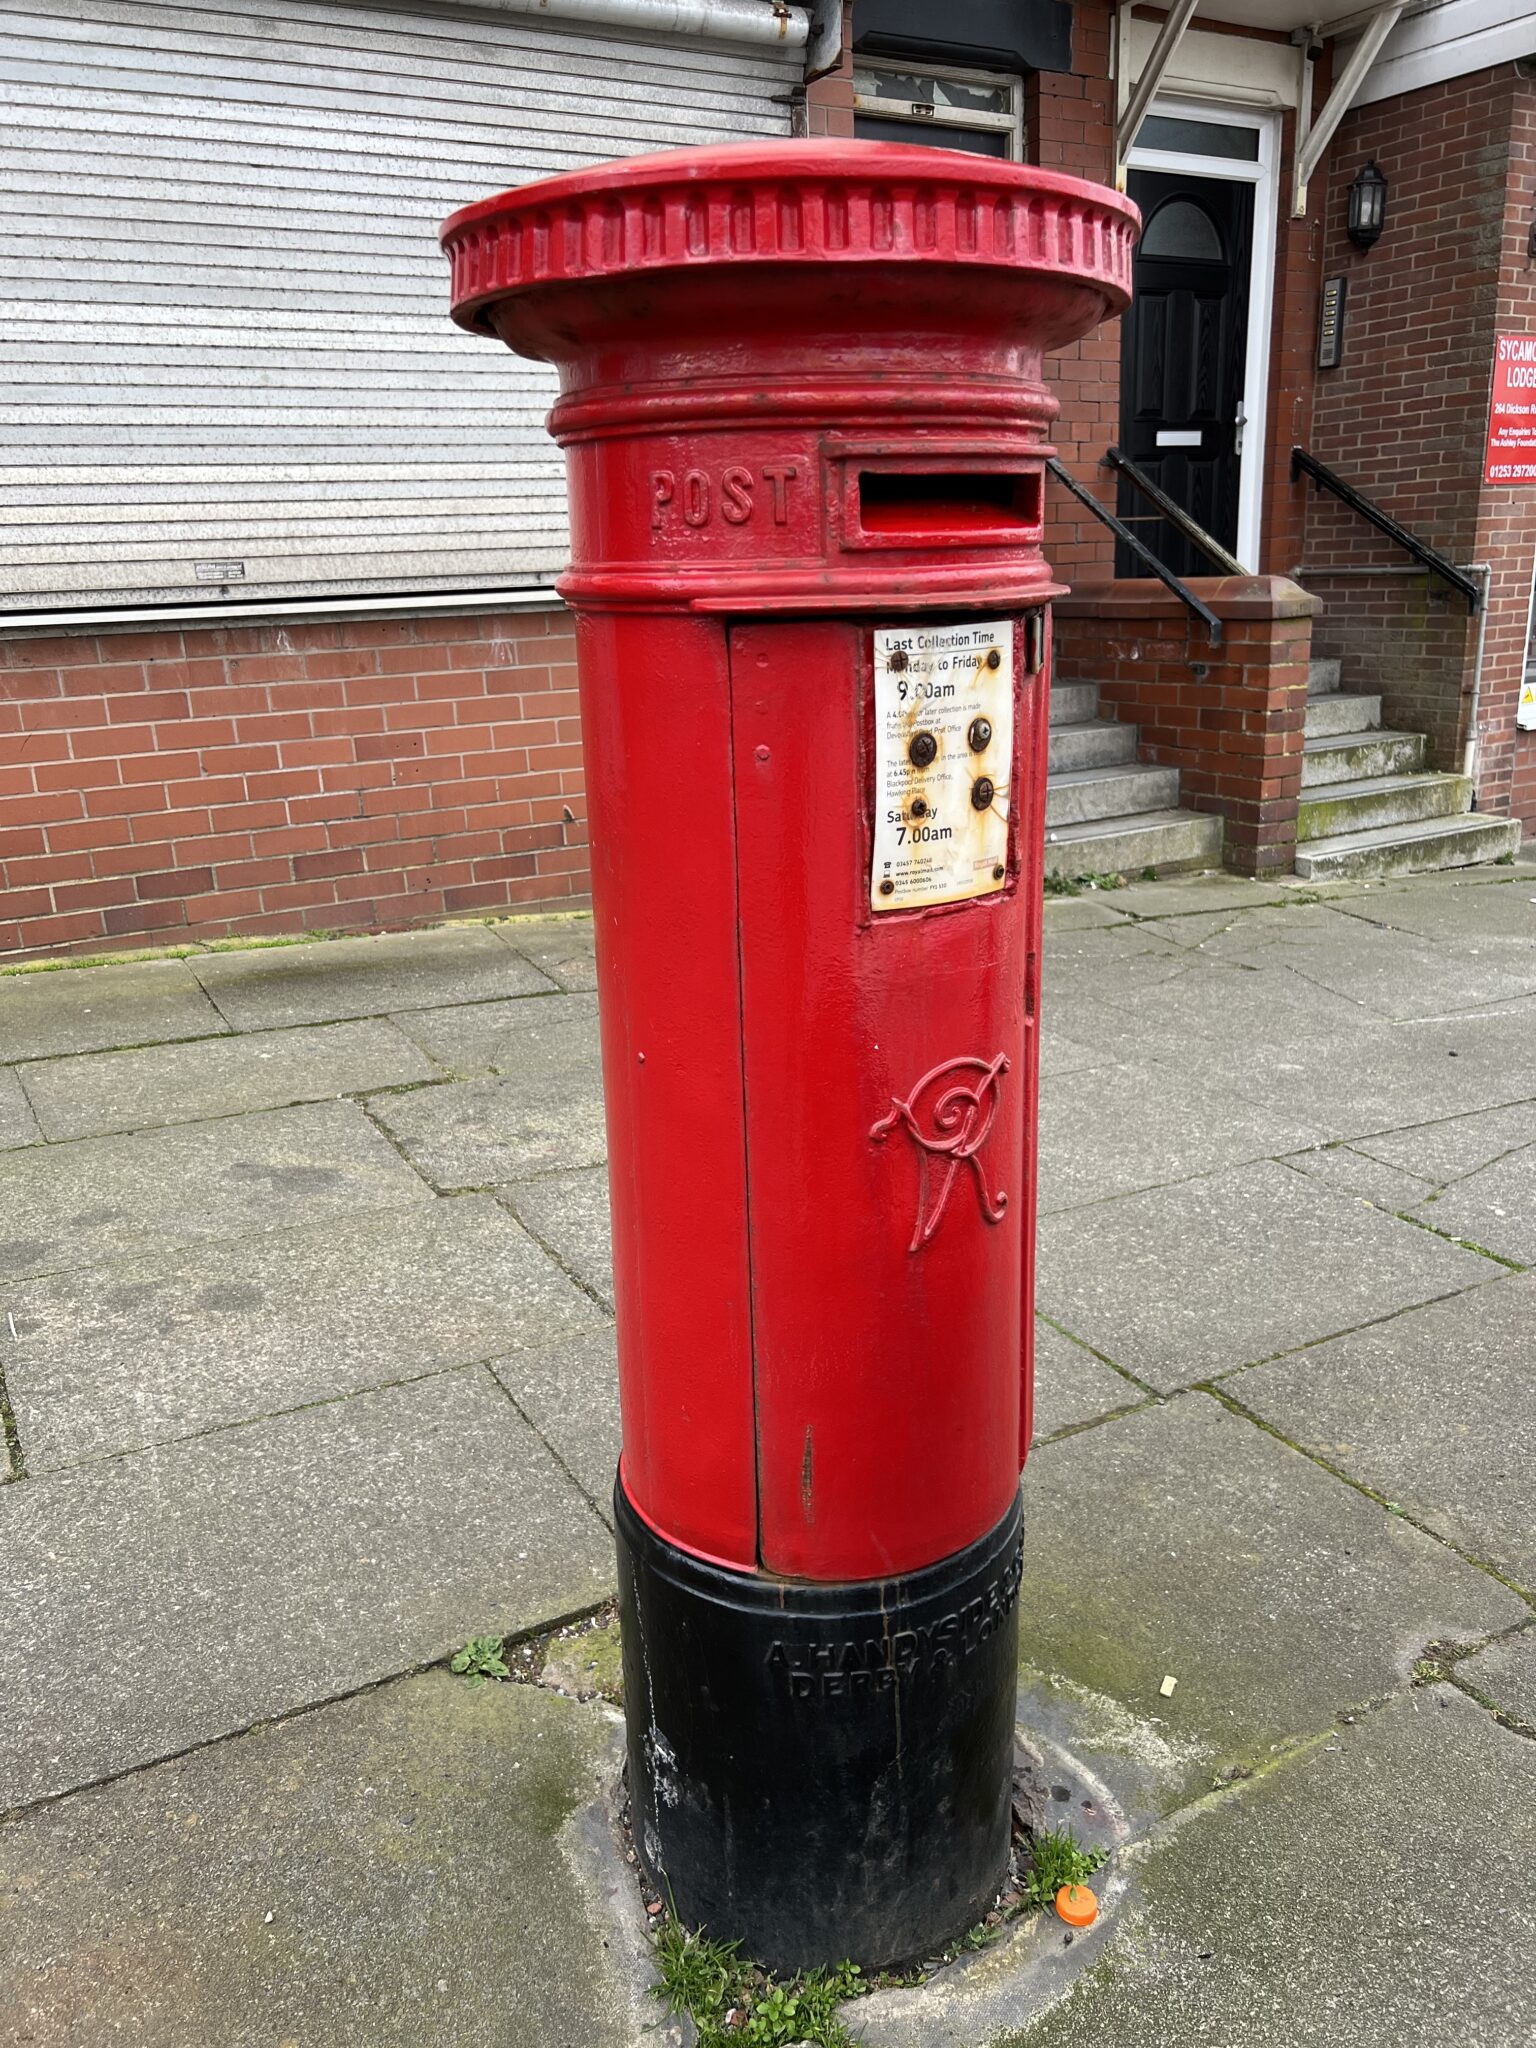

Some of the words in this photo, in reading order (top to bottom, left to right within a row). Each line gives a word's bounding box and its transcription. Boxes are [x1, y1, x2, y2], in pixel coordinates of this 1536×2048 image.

[1506, 403, 1530, 415] Dickson
[1498, 427, 1508, 437] Any
[1509, 427, 1531, 437] Enquiries
[1490, 438, 1500, 447] The
[1500, 438, 1516, 448] Ashley
[1490, 465, 1512, 478] 01253
[650, 466, 797, 529] POST
[886, 637, 913, 651] Last
[918, 633, 970, 649] Collection
[973, 631, 995, 644] Time
[886, 659, 934, 674] Mnday
[938, 660, 949, 671] to
[953, 655, 982, 670] Friday
[938, 704, 962, 714] collection
[896, 826, 952, 846] 7.00am
[789, 1655, 921, 1699] DERBY
